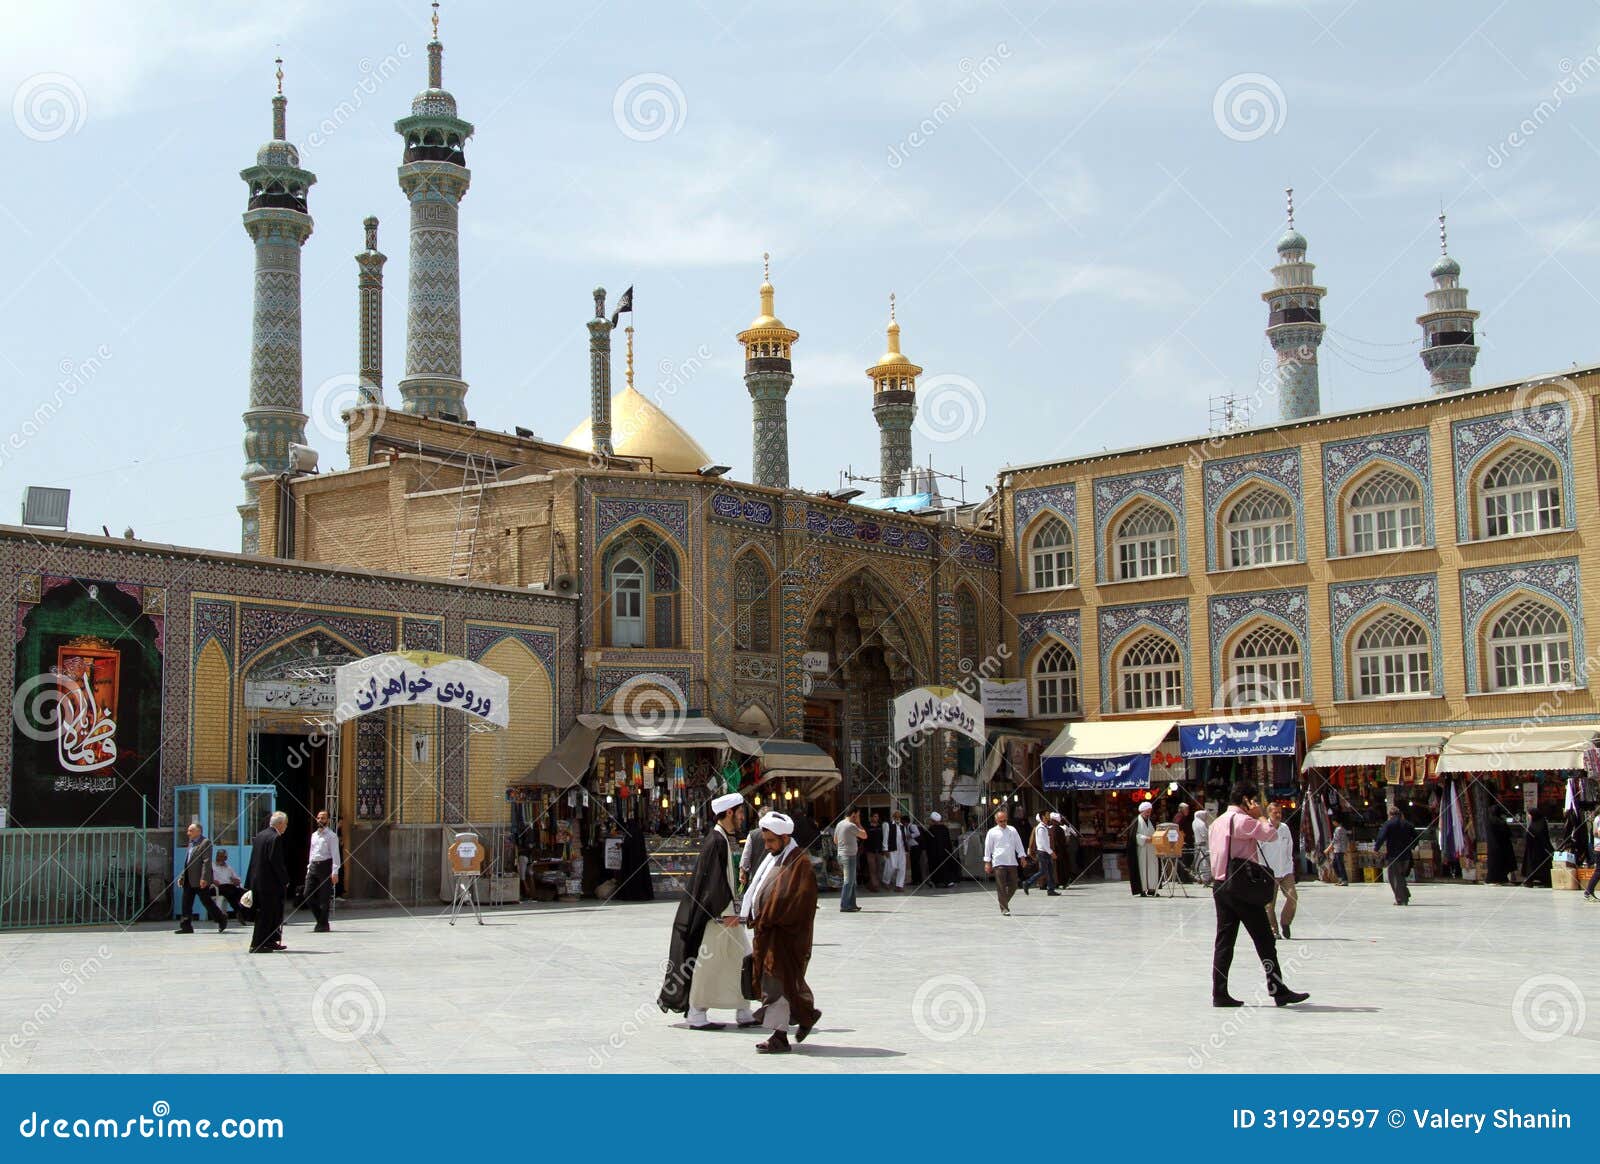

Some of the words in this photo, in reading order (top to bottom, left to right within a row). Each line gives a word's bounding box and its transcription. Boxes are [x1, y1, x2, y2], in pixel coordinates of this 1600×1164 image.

[356, 670, 433, 711] خواهران
[437, 681, 491, 718] ورودی
[907, 697, 942, 728] برادران
[943, 704, 975, 733] ورودی
[1252, 721, 1279, 743] عطر
[1062, 761, 1092, 773] محمد
[1095, 760, 1131, 777] سوهان
